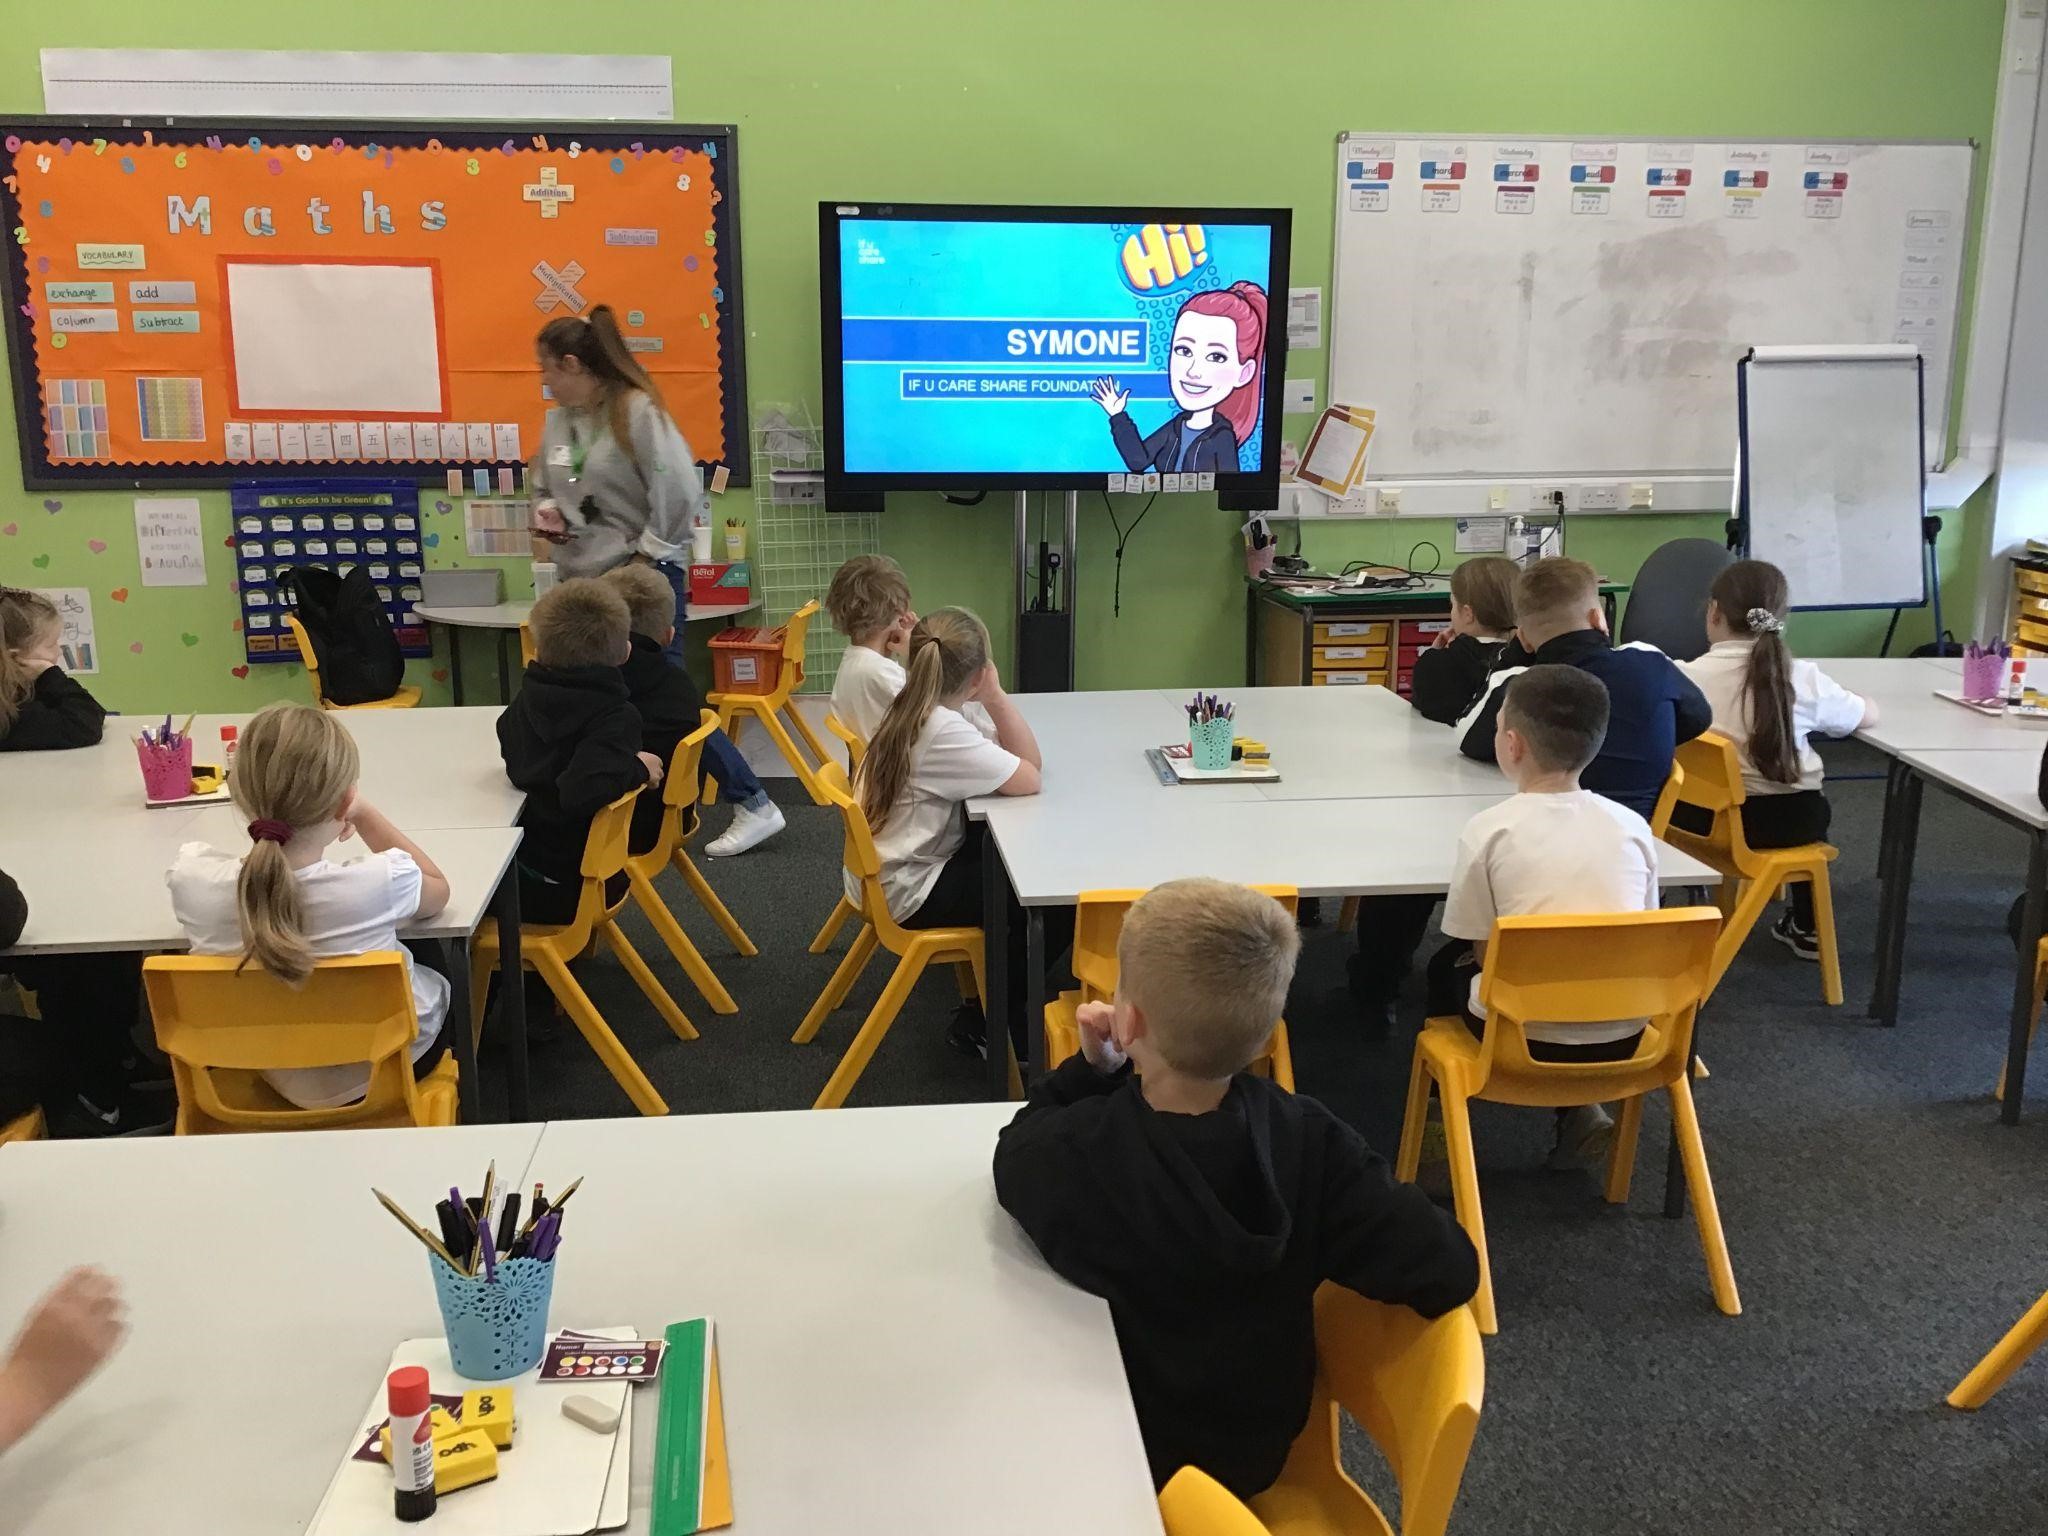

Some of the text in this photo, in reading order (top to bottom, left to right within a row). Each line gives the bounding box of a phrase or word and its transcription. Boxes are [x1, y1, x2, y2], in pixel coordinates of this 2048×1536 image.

[676, 174, 691, 192] 8
[530, 188, 568, 197] Addition
[81, 250, 134, 260] VOCABULARY
[1122, 224, 1208, 290] Hi!
[51, 288, 97, 300] exchange
[136, 286, 159, 299] add
[1007, 329, 1141, 356] SYMONE
[909, 379, 1121, 393] IF U CARE SHARE FOUNDATN
[287, 436, 299, 446] 二
[314, 435, 326, 446] 三
[367, 434, 379, 446] 五
[393, 433, 407, 446] 六
[421, 434, 433, 447] 七
[475, 434, 487, 448] 九
[502, 435, 513, 448] 十
